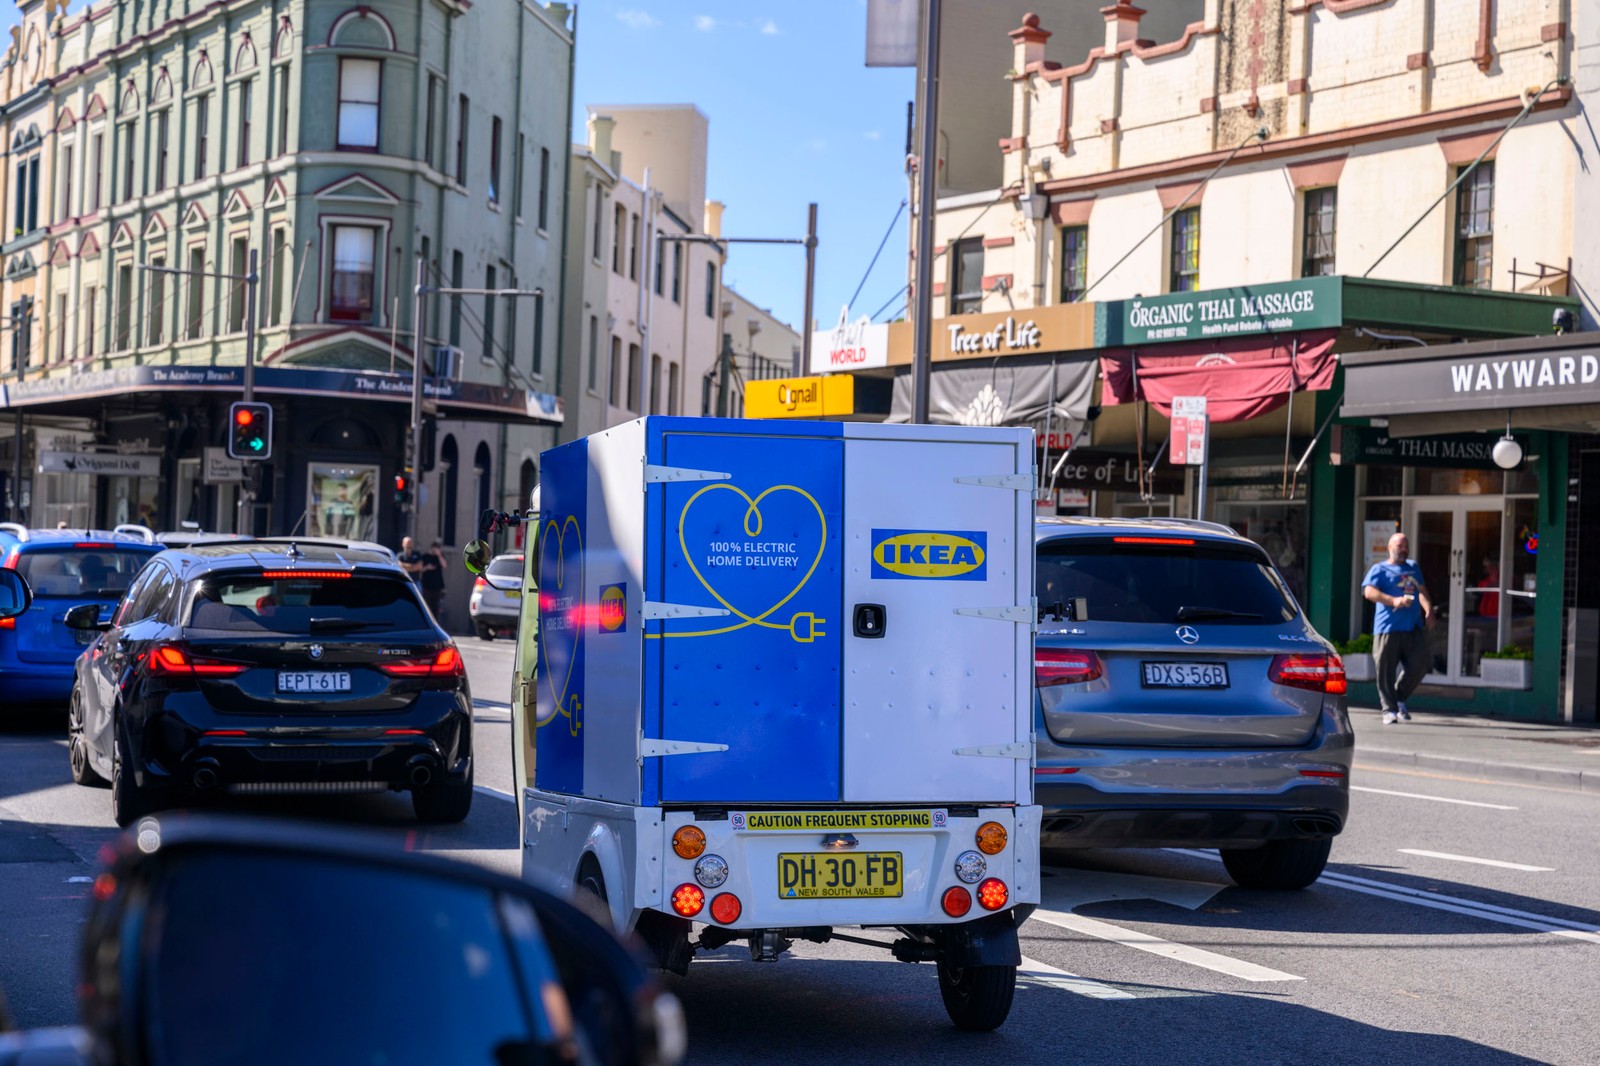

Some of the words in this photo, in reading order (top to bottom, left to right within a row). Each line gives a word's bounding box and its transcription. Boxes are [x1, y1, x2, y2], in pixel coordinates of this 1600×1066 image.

[1129, 301, 1194, 328] ORGANIC
[1198, 298, 1235, 321] THAI
[1241, 290, 1314, 317] MASSAGE
[947, 323, 981, 352] Tree
[982, 322, 1004, 350] of
[1005, 316, 1040, 347] Life
[1202, 323, 1223, 335] Health
[1223, 322, 1239, 334] Fund
[1239, 320, 1262, 332] Rebate
[830, 347, 866, 365] WORLD
[153, 370, 168, 381] The
[168, 370, 205, 383] Academy
[1451, 355, 1599, 392] WAYWARD
[355, 378, 376, 389] The
[778, 382, 818, 411] Cignall
[1398, 439, 1438, 458] THAI
[1441, 441, 1494, 459] MASSA
[77, 457, 118, 472] Origami
[120, 458, 141, 470] Doll
[1095, 458, 1117, 484] of
[709, 541, 741, 553] 100%
[744, 542, 796, 554] ELECTRIC
[883, 543, 979, 566] IKEA
[707, 555, 742, 567] HOME
[745, 556, 799, 567] DELIVERY
[749, 814, 801, 828] CAUTION
[805, 814, 867, 828] FREQUENT
[871, 813, 929, 827] STOPPING
[798, 888, 819, 896] NEW
[822, 888, 852, 896] SOUTH
[856, 887, 885, 896] WALES
